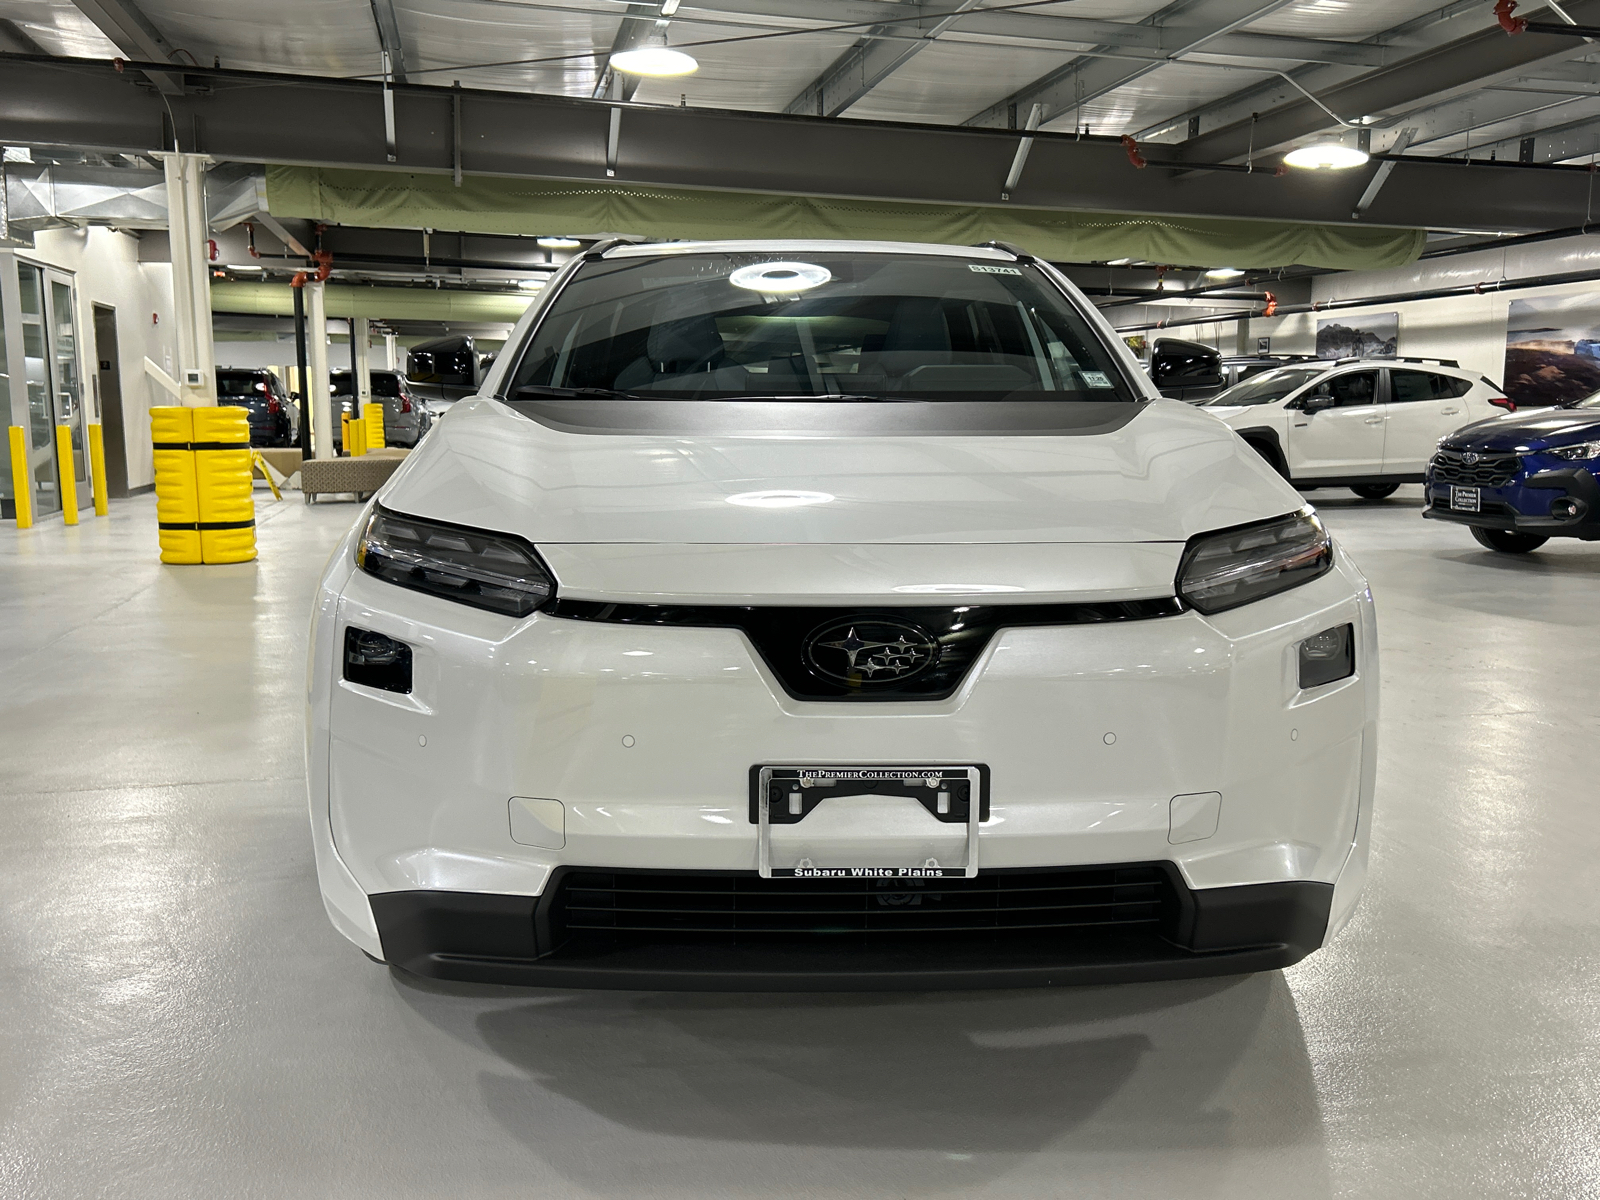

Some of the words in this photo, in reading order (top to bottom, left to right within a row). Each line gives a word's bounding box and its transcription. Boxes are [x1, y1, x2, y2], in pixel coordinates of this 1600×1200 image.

[794, 868, 846, 877] Subaru
[851, 868, 893, 877] White
[898, 868, 943, 877] Plains
